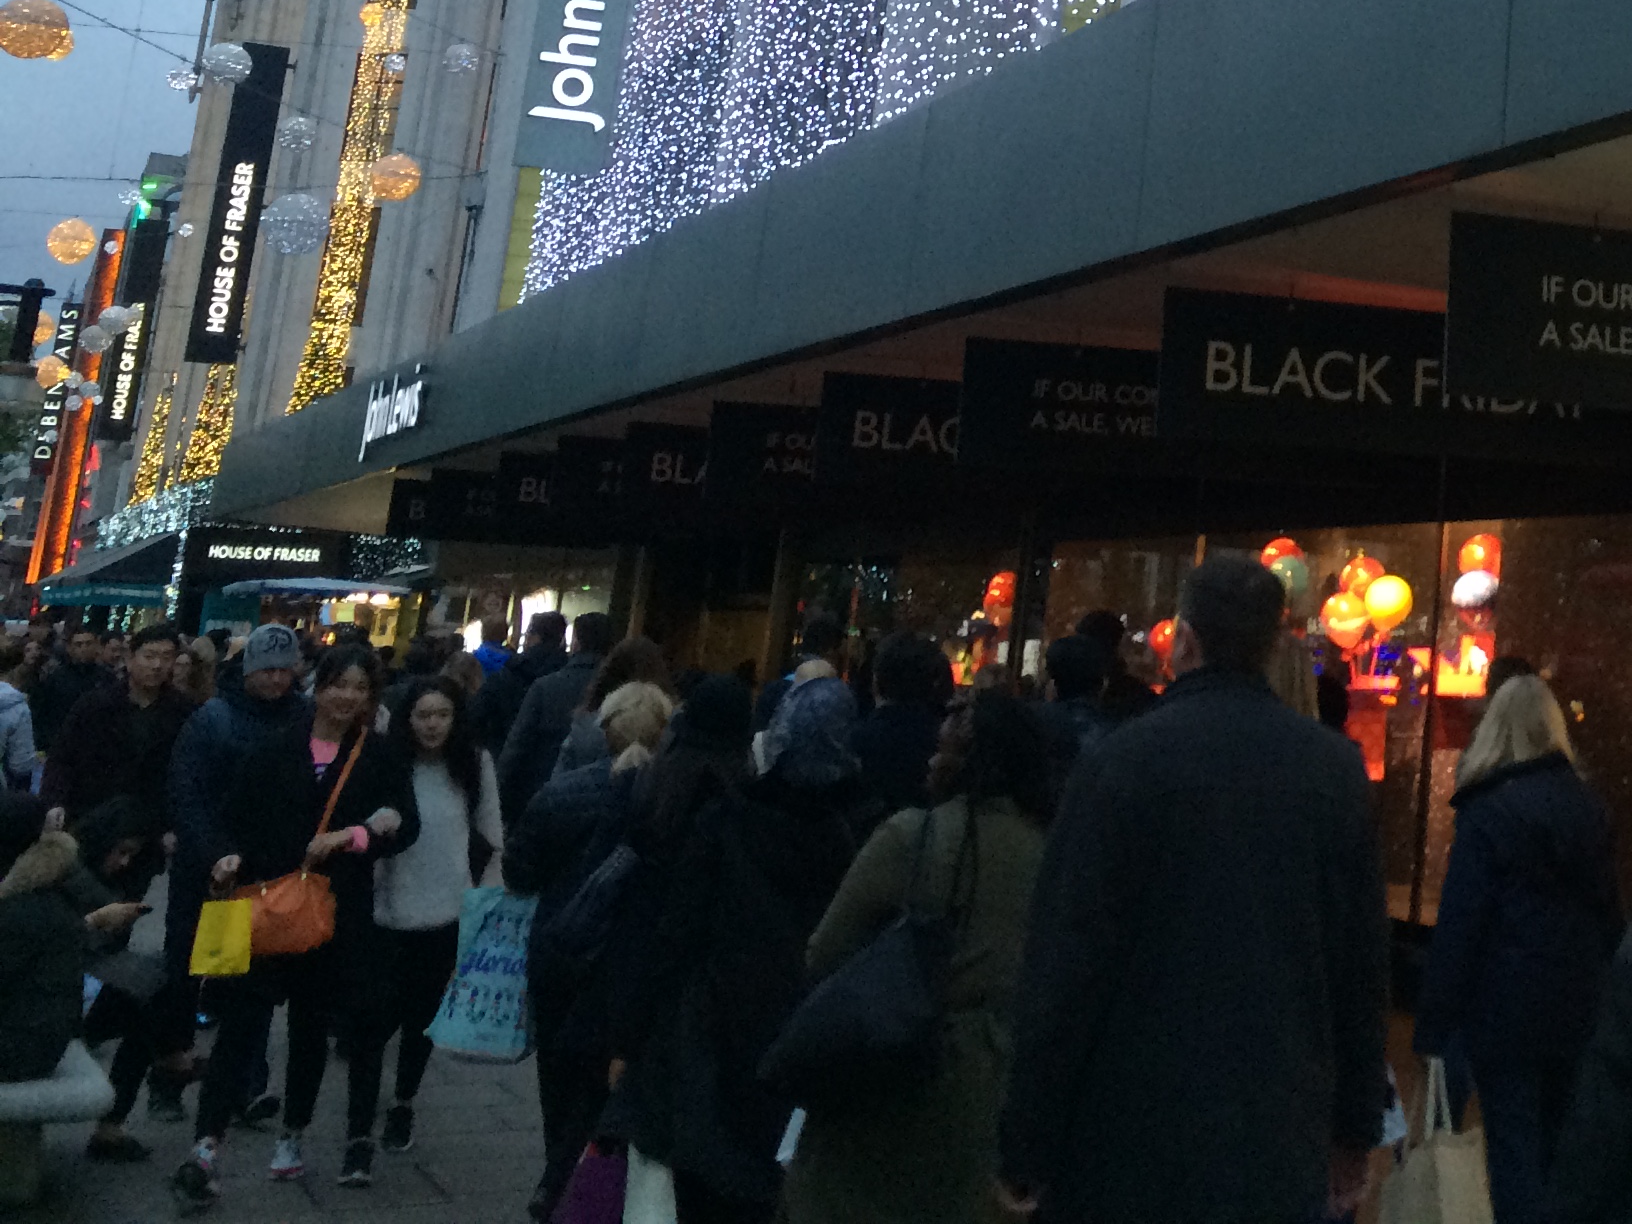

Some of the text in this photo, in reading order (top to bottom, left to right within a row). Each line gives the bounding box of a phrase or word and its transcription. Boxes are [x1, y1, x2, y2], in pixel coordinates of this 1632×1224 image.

[205, 161, 255, 333] HOUSE OF FRASER
[1541, 274, 1565, 303] IF
[1538, 319, 1562, 348] A
[119, 350, 136, 372] OF
[1205, 339, 1393, 405] BLACK
[110, 371, 132, 420] HOUSE
[1057, 380, 1108, 403] OUR
[1030, 409, 1049, 428] A
[207, 544, 321, 562] HOUSE OF FRASER
